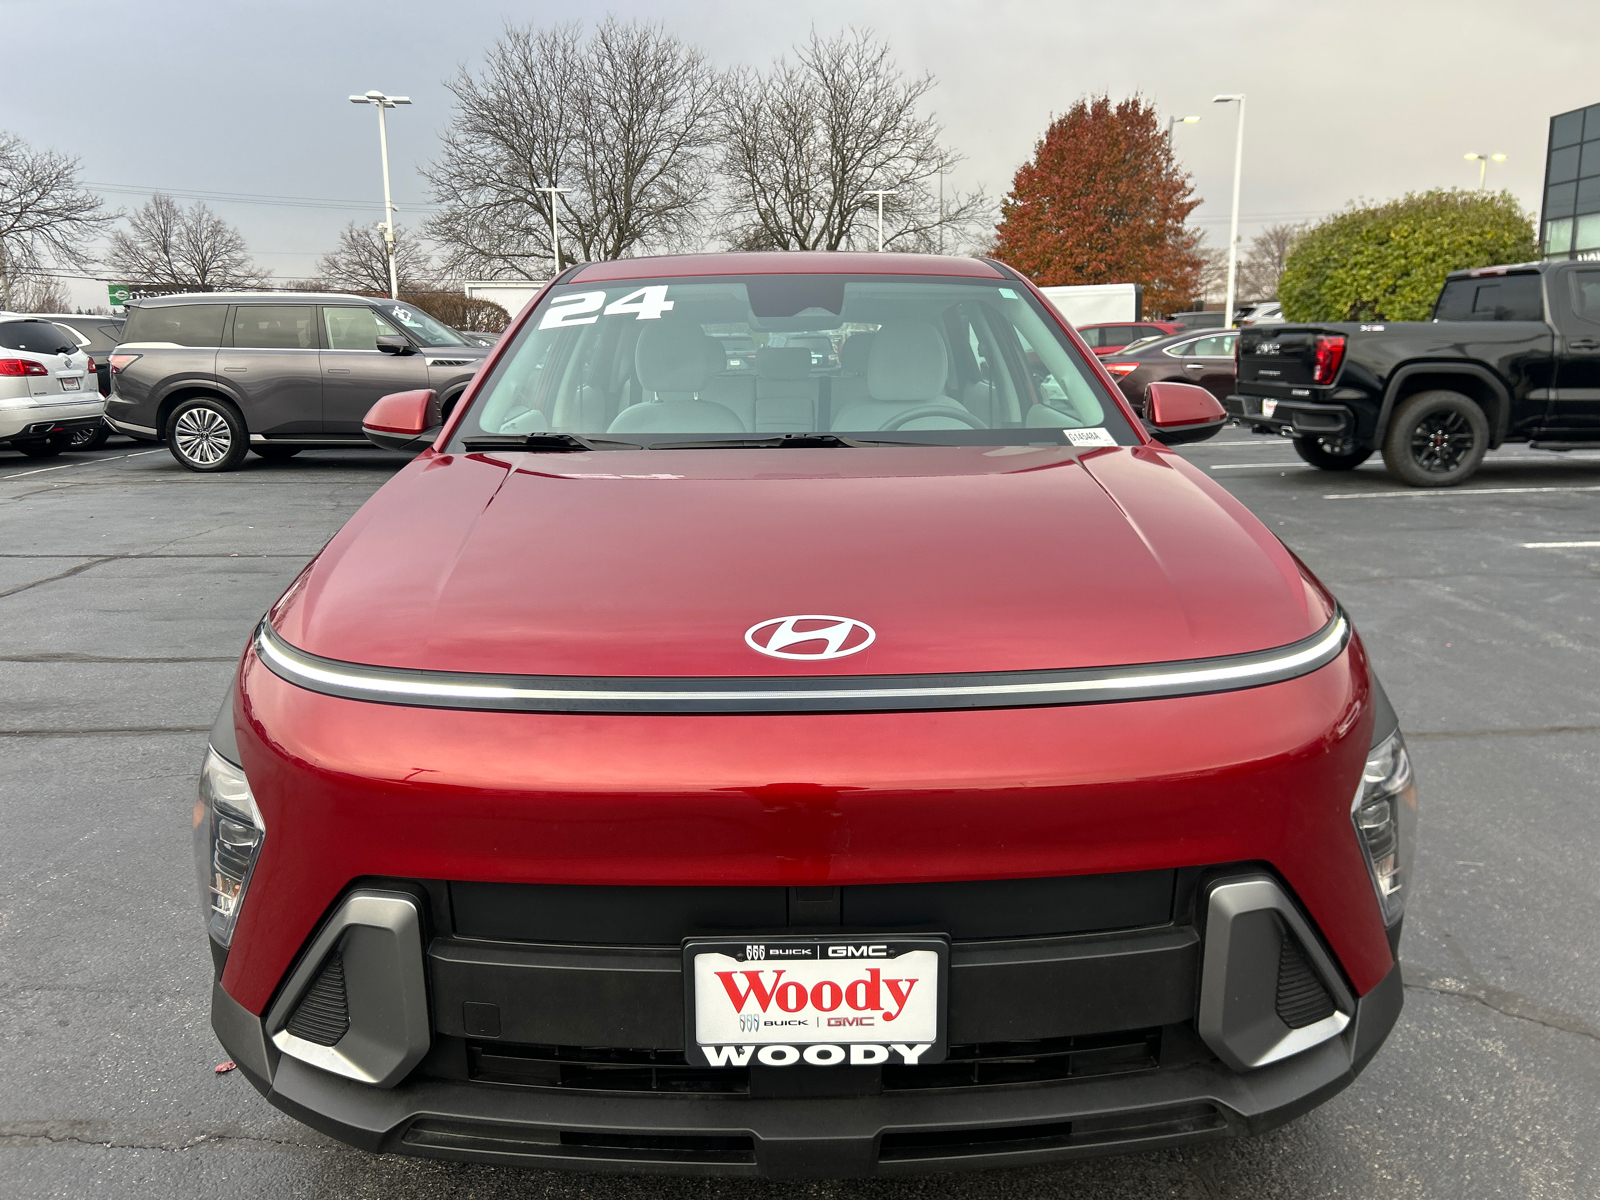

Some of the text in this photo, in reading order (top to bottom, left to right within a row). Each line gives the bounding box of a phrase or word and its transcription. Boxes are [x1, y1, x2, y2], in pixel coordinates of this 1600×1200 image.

[538, 285, 675, 330] 24
[827, 945, 888, 957] GMC
[714, 967, 919, 1022] Woody
[826, 1016, 875, 1027] GMC
[701, 1044, 932, 1067] WOODY
